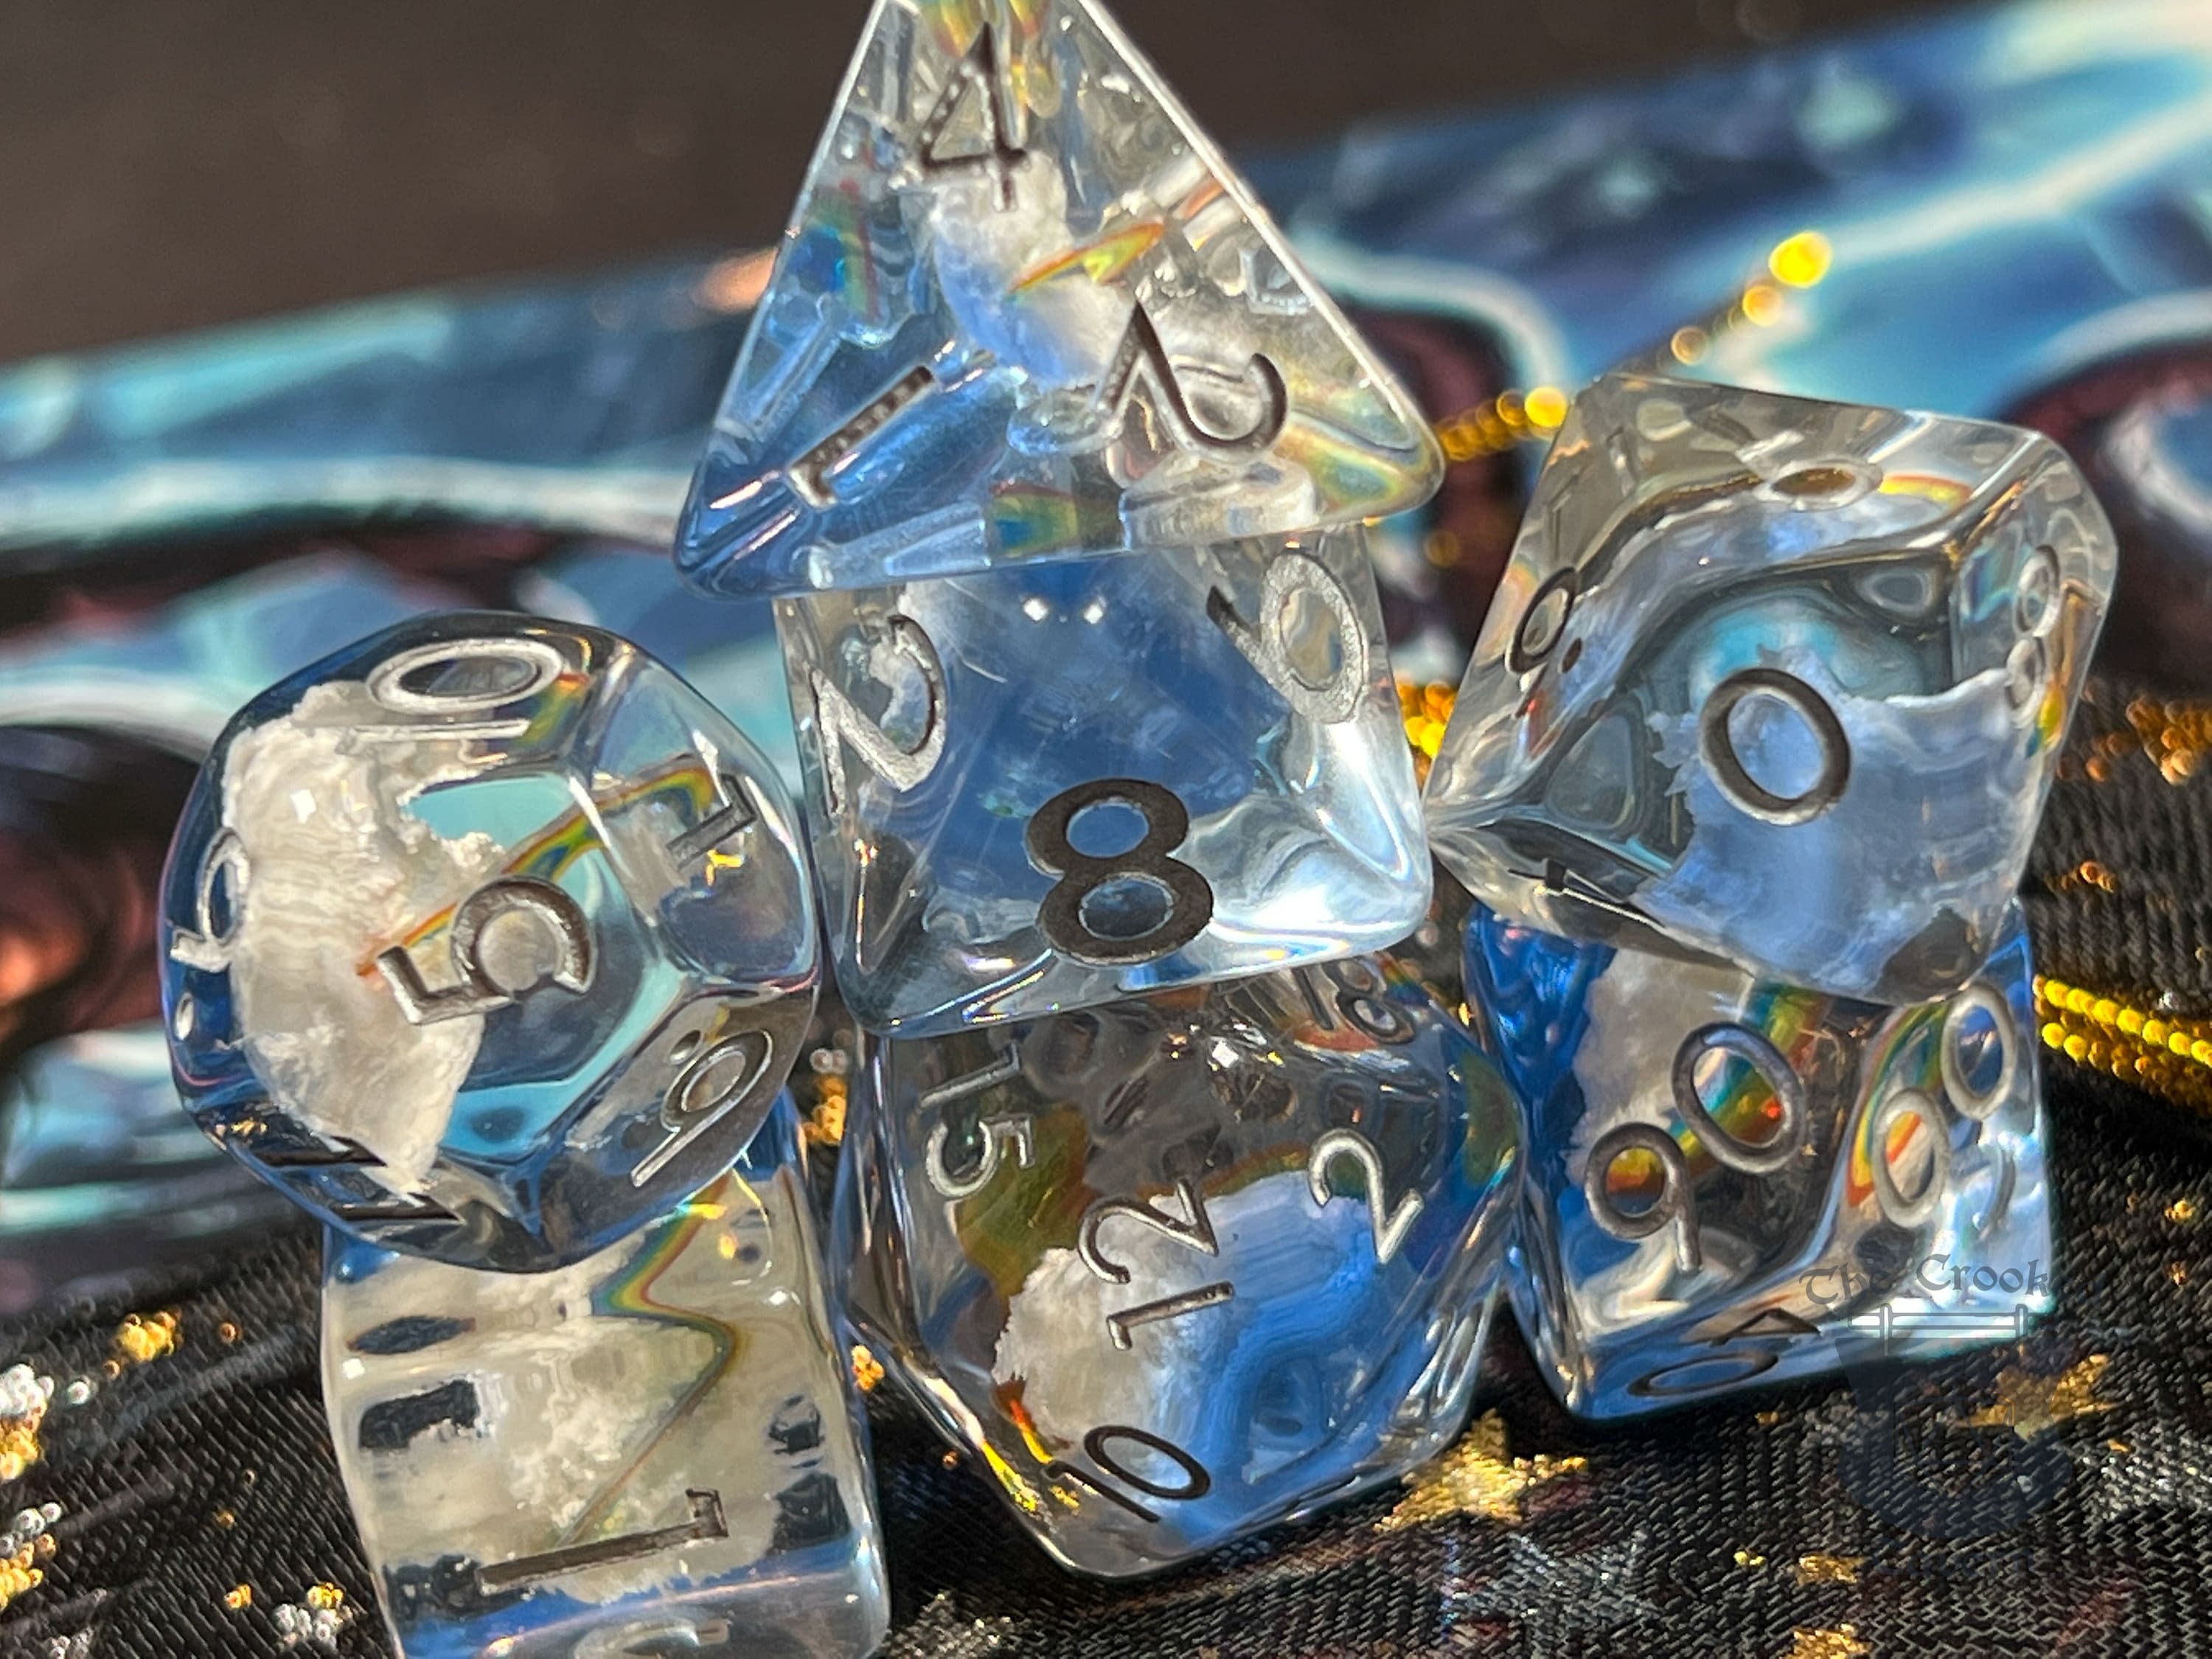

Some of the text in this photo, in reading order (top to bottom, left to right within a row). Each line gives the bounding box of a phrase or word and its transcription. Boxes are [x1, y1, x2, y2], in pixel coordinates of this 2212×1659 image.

[917, 22, 1026, 212] 4
[1094, 298, 1290, 459] 2
[809, 614, 947, 818] 2
[1699, 667, 1851, 826] 0
[377, 876, 597, 1026] 5
[1023, 778, 1214, 966] 8
[1077, 1182, 1236, 1352] 12
[1307, 1127, 1425, 1265] 2
[1040, 1425, 1212, 1524] 10
